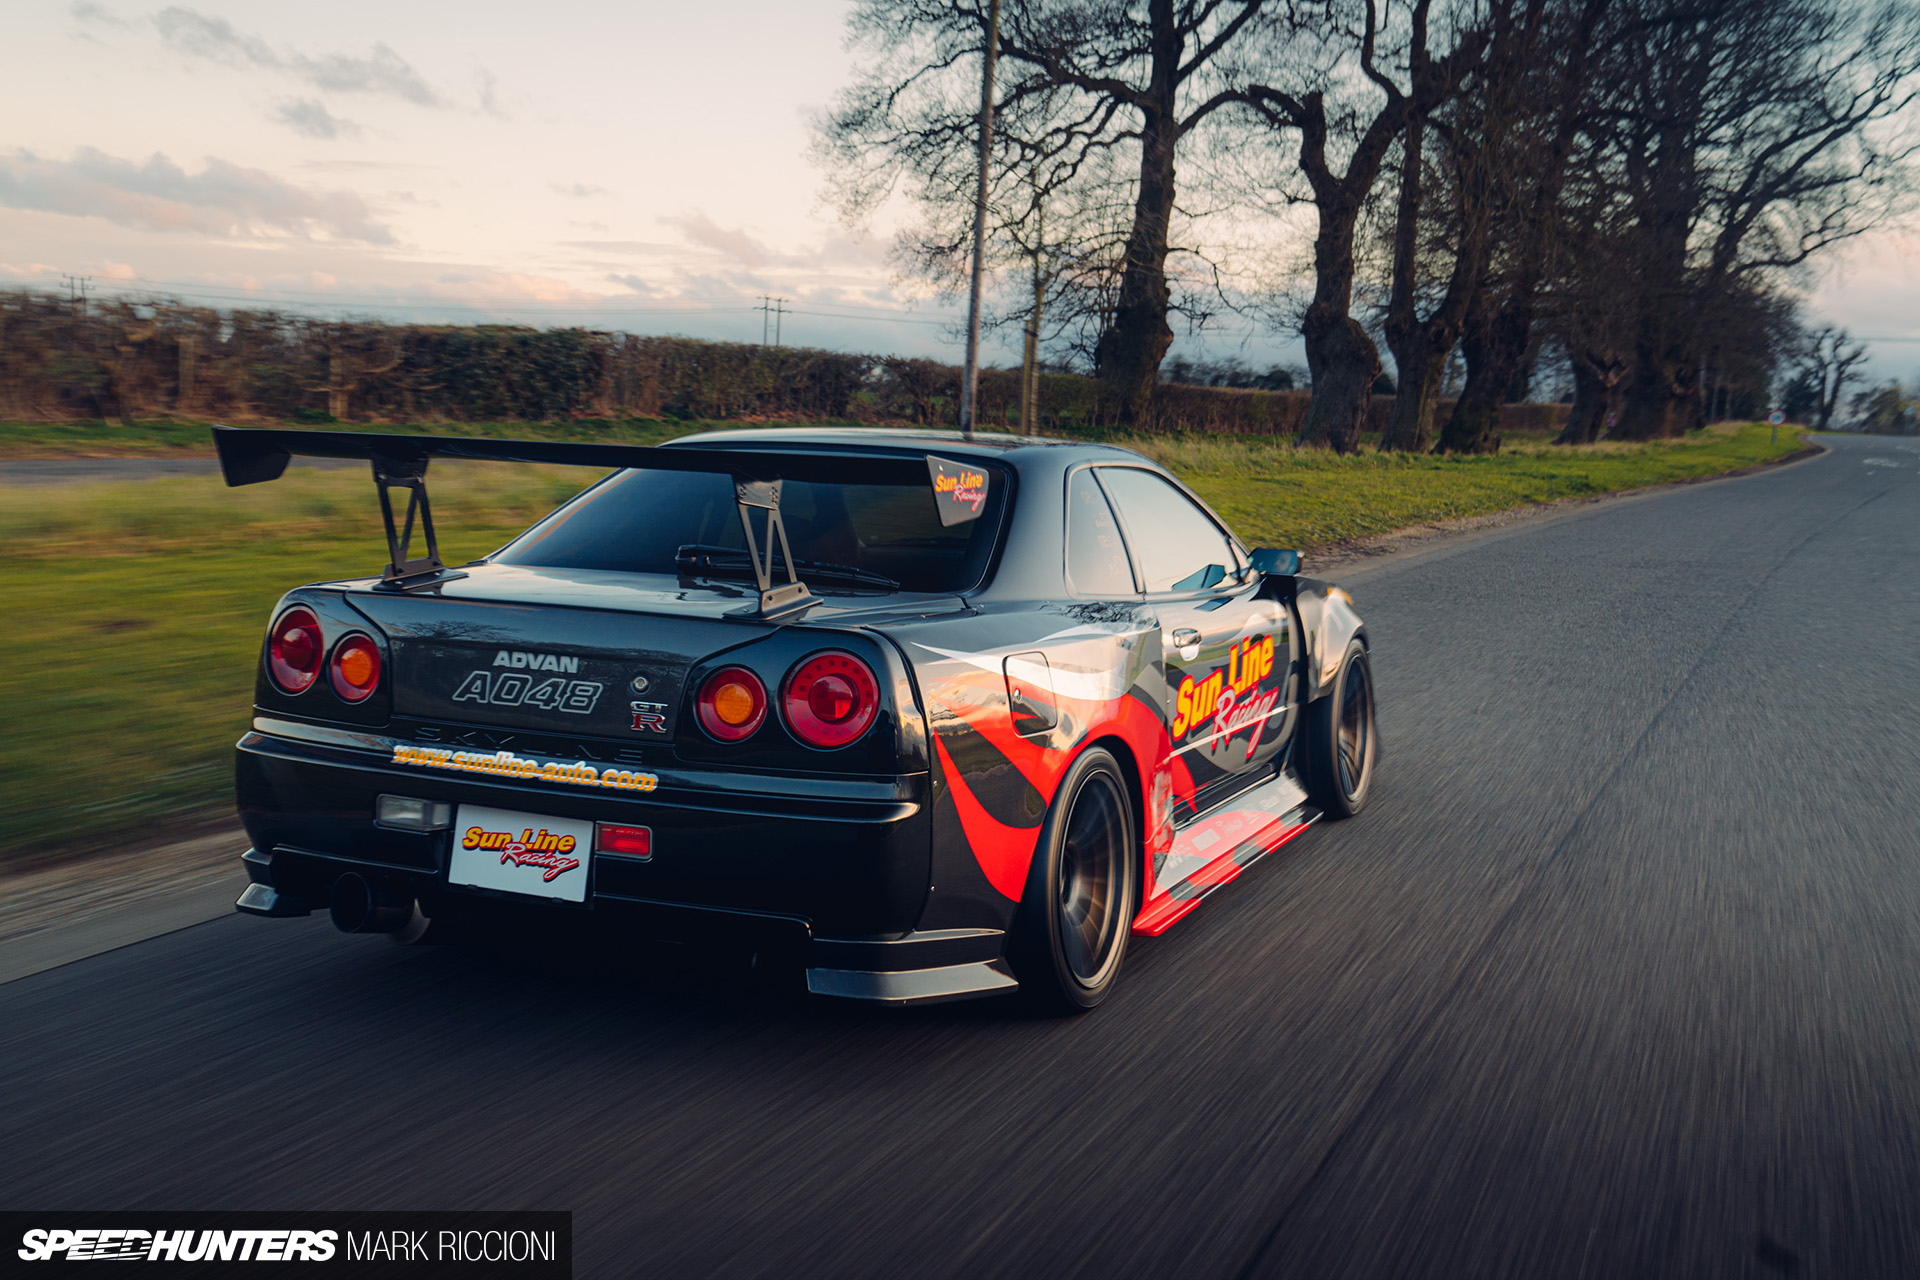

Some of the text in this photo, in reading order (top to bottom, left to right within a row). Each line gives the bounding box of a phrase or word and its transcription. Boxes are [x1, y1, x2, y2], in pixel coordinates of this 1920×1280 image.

[935, 470, 984, 493] Sun Line
[492, 650, 579, 674] ADVAN
[1172, 634, 1275, 742] Sun Line
[630, 700, 669, 713] GT
[630, 710, 668, 734] R
[1211, 684, 1279, 760] Racing
[392, 744, 659, 792] www.sunline-auto.com
[462, 826, 576, 855] Sun Line
[500, 841, 580, 883] Racing
